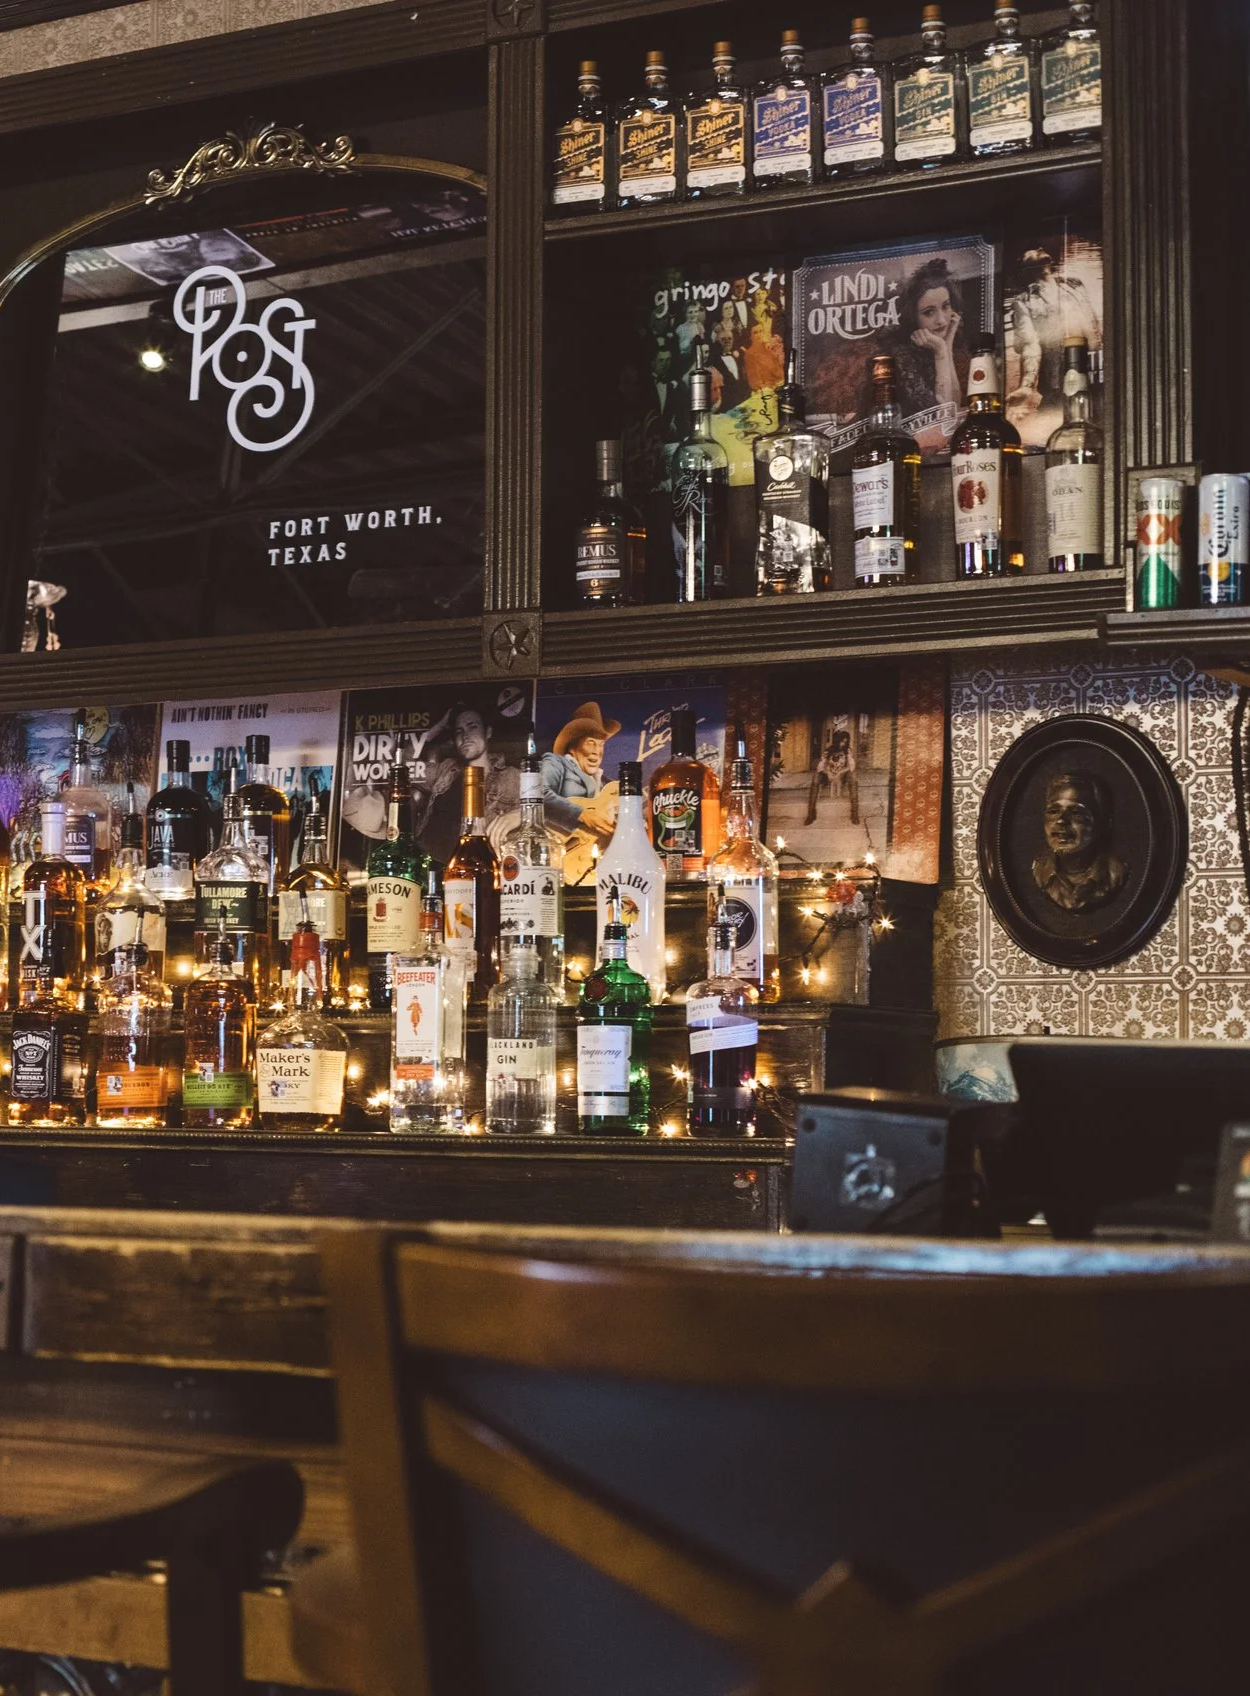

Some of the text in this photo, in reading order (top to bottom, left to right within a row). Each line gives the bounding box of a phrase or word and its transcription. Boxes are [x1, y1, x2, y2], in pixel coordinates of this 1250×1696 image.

[832, 88, 871, 113] Shiner
[903, 84, 943, 109] Shiner
[762, 101, 801, 124] Shiner
[627, 124, 666, 147] Shiner
[695, 113, 735, 137] Shiner
[560, 132, 596, 155] Shiner
[209, 288, 228, 304] THE
[820, 269, 887, 306] LINDI
[654, 281, 730, 318] gringo
[807, 294, 901, 339] ORTEGA
[269, 505, 443, 540] FORT WORTH,
[268, 541, 348, 567] TEXAS
[578, 544, 617, 559] REMUS
[171, 703, 269, 723] AIN'T NOTHIN' FANCY
[368, 712, 430, 730] PHILLIPS
[353, 732, 430, 762] DIRY
[353, 761, 427, 781] WONER
[652, 789, 700, 815] Chuckle
[65, 832, 88, 843] MUS
[200, 884, 247, 898] TULLAMORE
[368, 882, 412, 898] MESON
[501, 880, 535, 896] CARDÍ
[598, 873, 652, 895] MALIBU
[397, 971, 436, 985] BEEFEATER
[13, 1036, 27, 1050] JACK
[259, 1053, 311, 1063] Maker's
[497, 1054, 517, 1065] GIN
[272, 1066, 311, 1077] Mark
